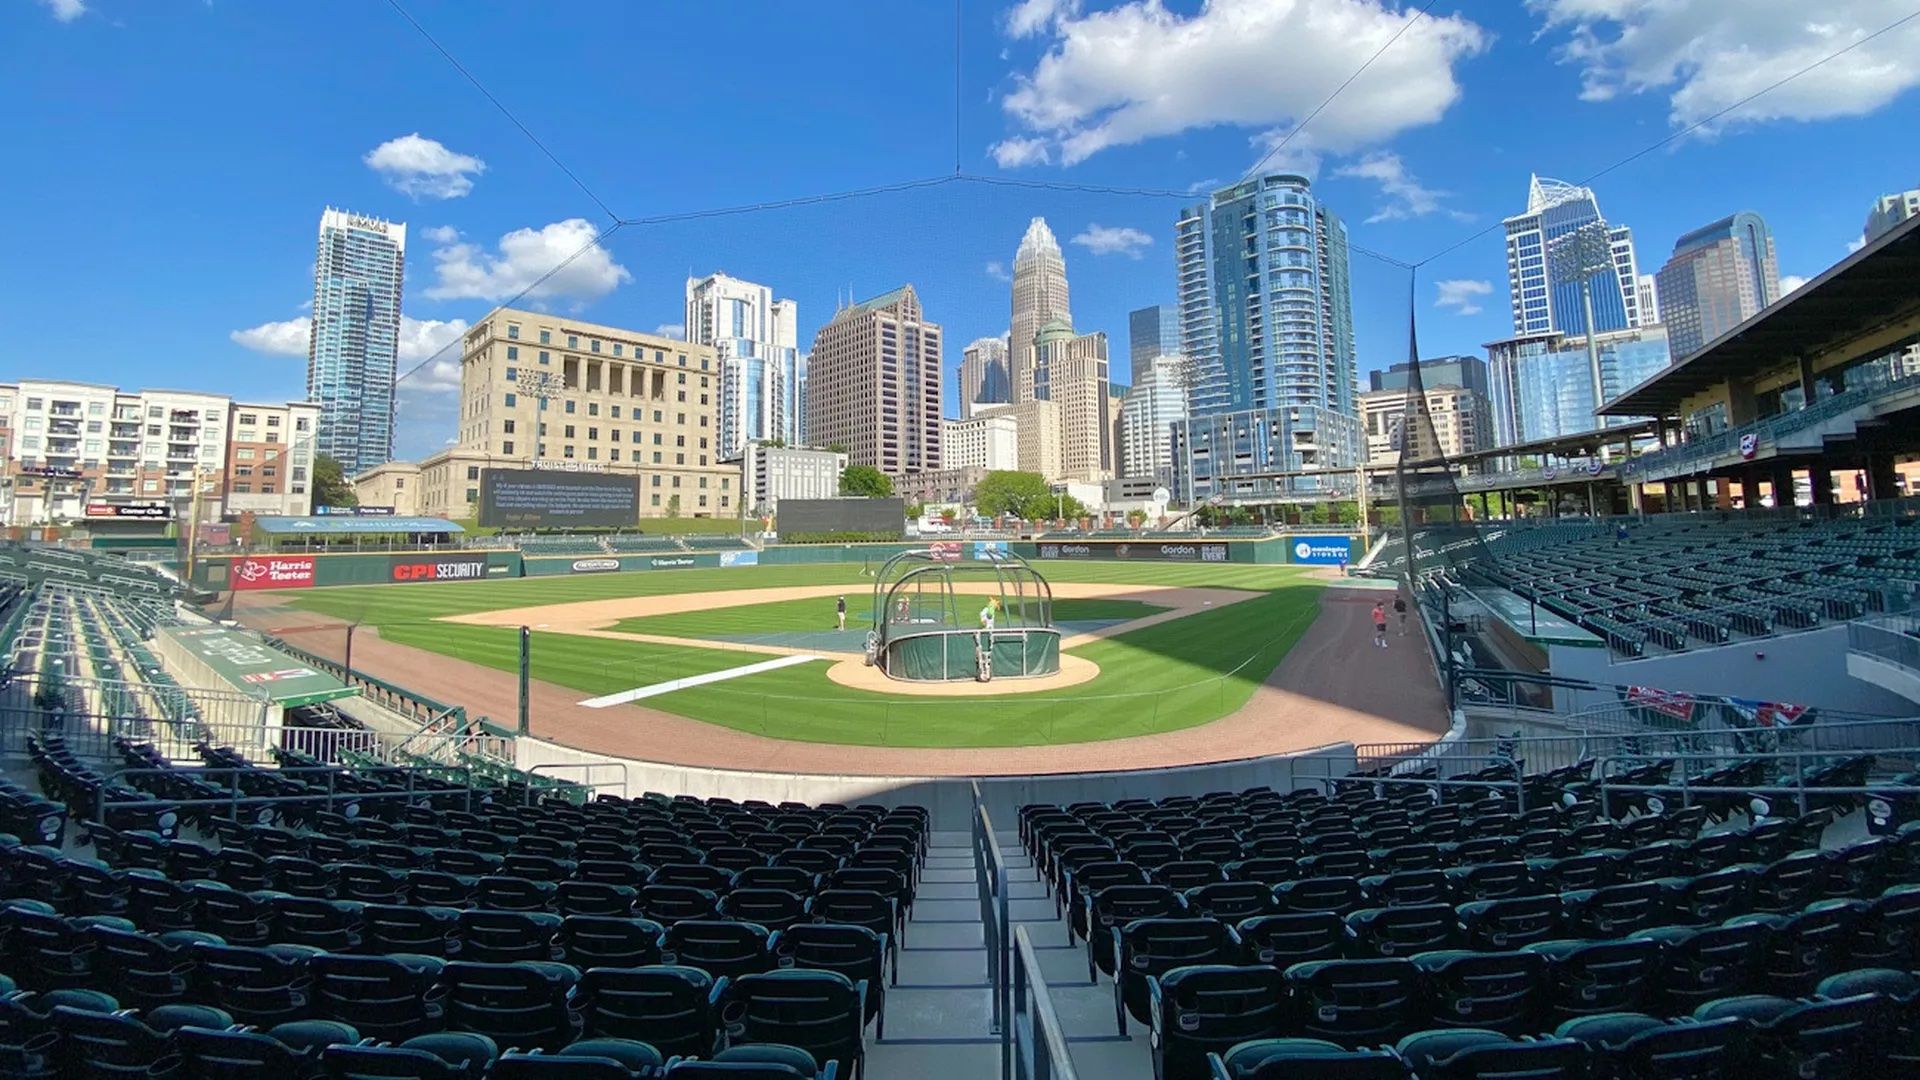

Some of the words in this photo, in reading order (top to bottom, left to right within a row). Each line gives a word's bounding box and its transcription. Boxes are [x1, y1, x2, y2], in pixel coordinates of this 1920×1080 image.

[1062, 544, 1090, 553] Gordon
[1161, 545, 1196, 554] Gordon
[270, 561, 312, 571] Harris
[394, 564, 436, 579] CPI
[437, 562, 483, 578] SECURITY
[269, 571, 311, 580] Teeter
